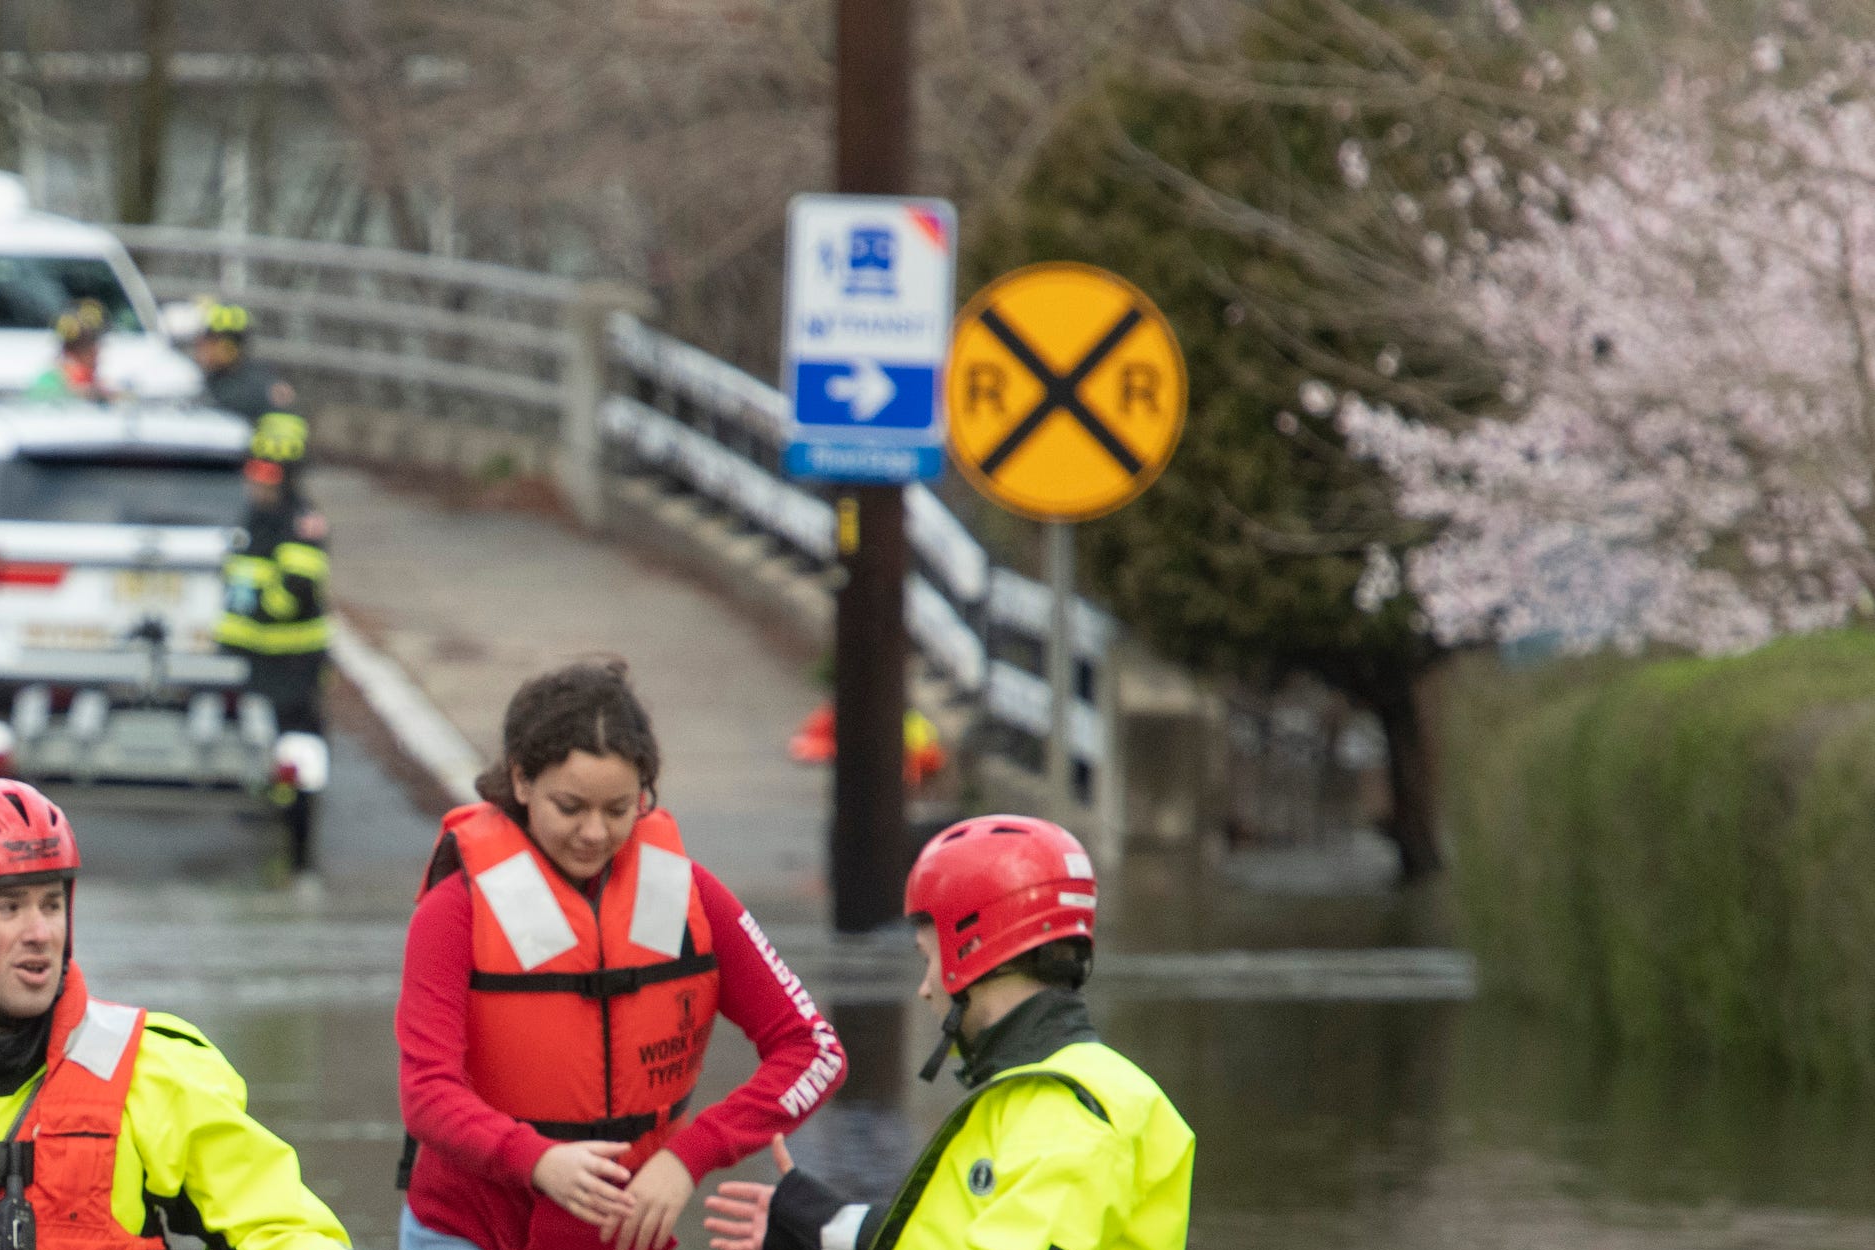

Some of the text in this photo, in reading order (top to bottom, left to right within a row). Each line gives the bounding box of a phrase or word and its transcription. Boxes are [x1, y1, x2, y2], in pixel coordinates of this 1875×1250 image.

[965, 361, 1161, 417] R R
[639, 1035, 687, 1066] WORK
